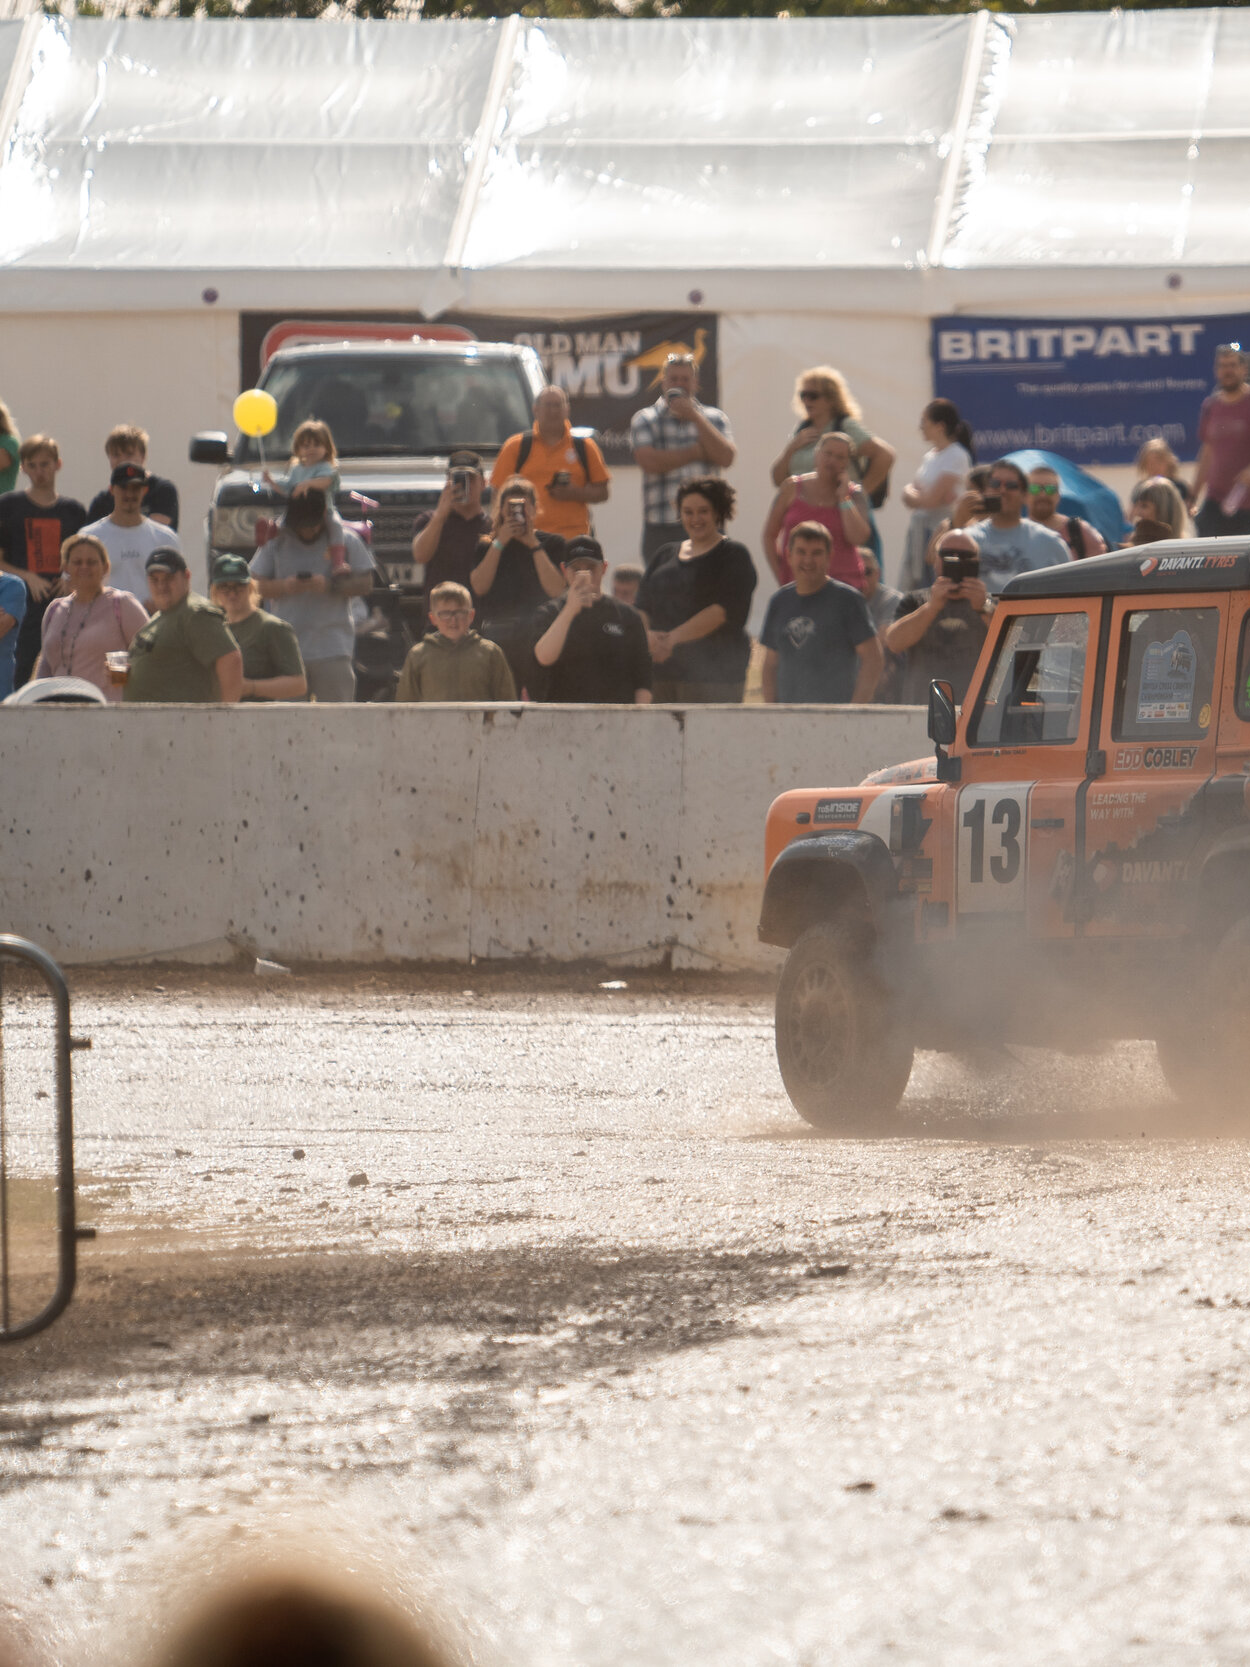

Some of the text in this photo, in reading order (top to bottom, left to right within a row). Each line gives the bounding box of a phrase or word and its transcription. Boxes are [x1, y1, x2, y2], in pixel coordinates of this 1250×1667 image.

[514, 332, 641, 353] OLD MAN
[938, 324, 1205, 361] BRITPART
[543, 353, 641, 398] MU
[973, 423, 1187, 449] www.britpart.com
[1158, 555, 1238, 570] DAVANTI TYRES
[1114, 746, 1199, 770] EDD COBLEY
[1092, 792, 1147, 805] LEADING THE
[1089, 807, 1134, 820] WAY WITH
[963, 798, 1021, 883] 13
[1122, 861, 1189, 883] DAVANTI
